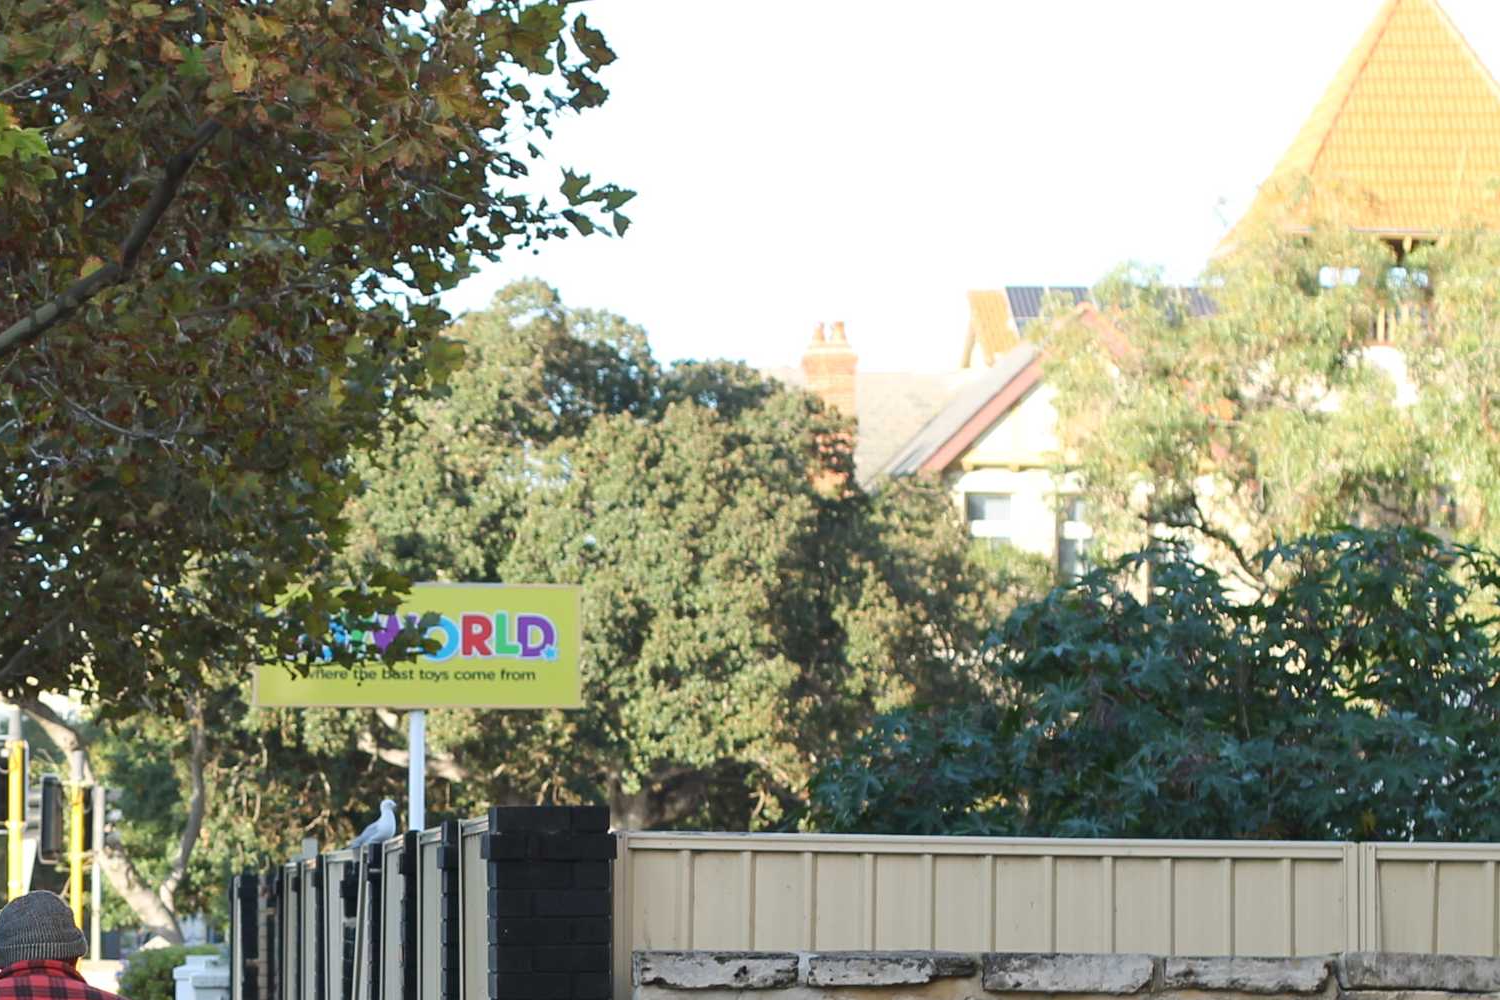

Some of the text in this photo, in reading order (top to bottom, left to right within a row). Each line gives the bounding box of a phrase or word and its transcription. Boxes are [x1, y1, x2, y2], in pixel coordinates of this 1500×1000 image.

[284, 611, 558, 662] WORLD
[353, 668, 377, 680] the
[420, 669, 449, 683] toys
[454, 671, 496, 681] come
[501, 668, 536, 681] from
